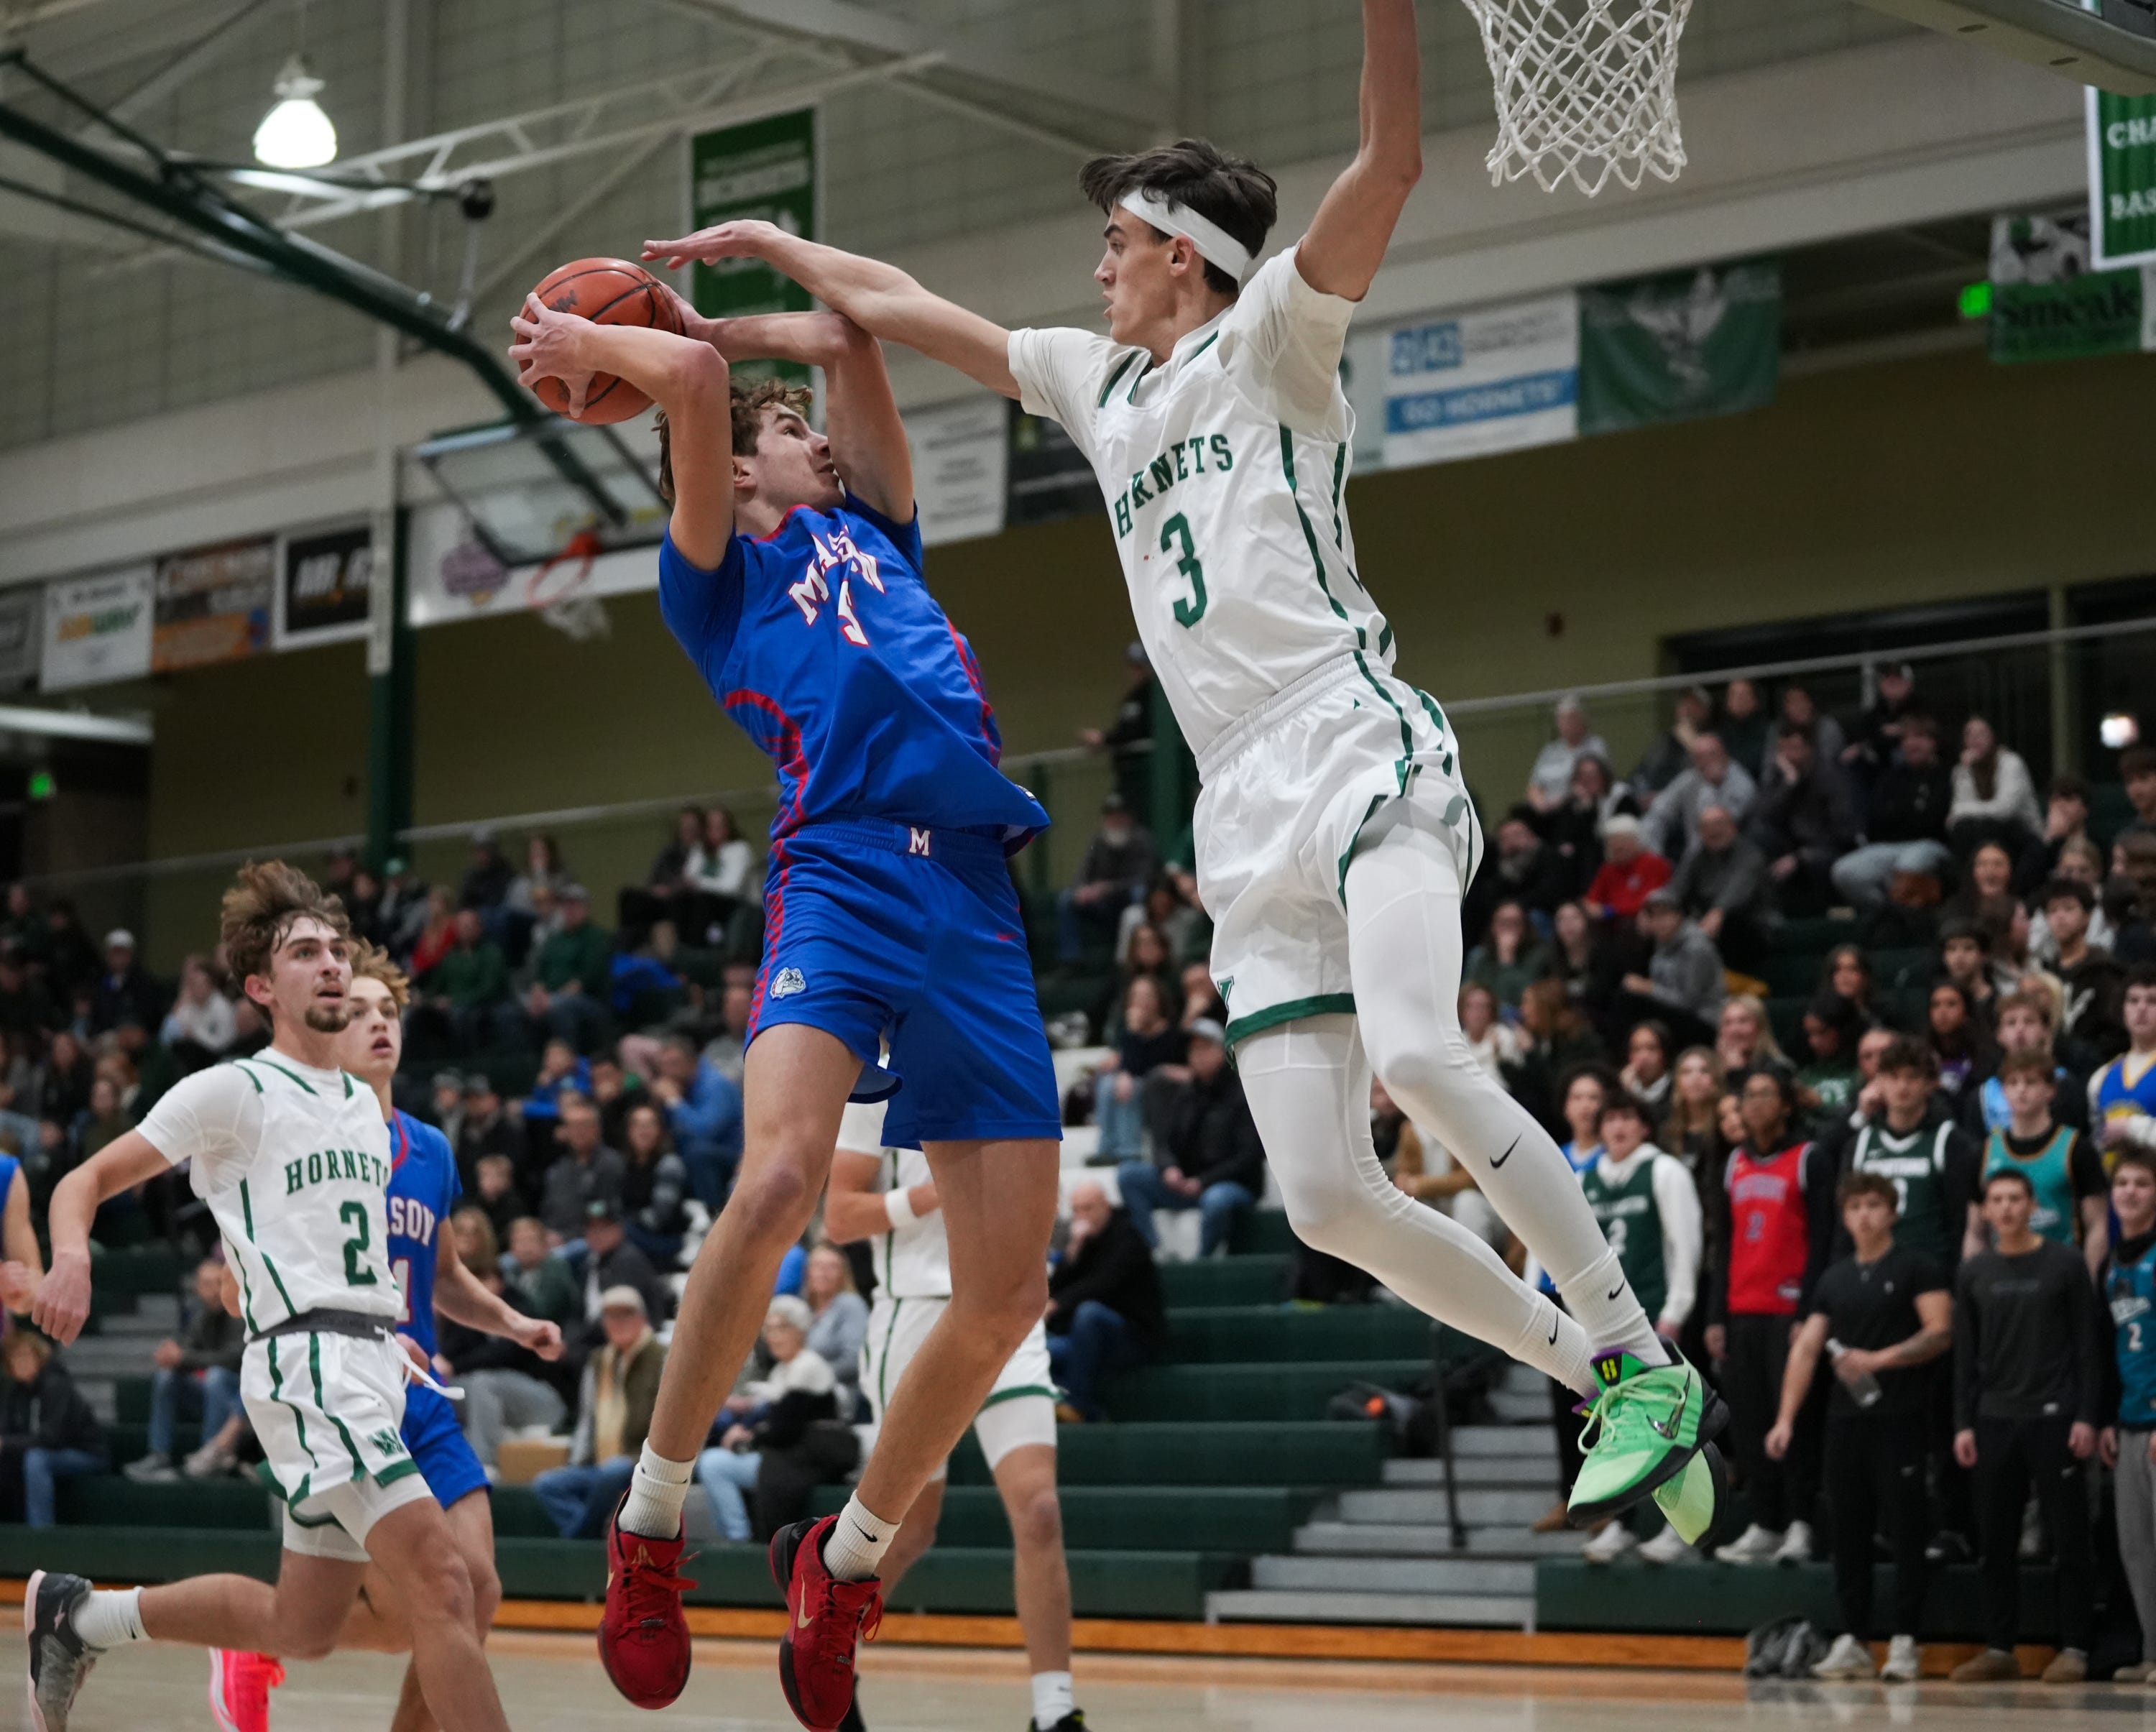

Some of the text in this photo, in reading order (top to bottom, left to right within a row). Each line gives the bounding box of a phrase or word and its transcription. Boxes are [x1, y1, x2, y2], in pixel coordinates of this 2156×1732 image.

[1161, 512, 1207, 629] 3
[909, 827, 931, 856] M
[340, 1201, 377, 1286] 2
